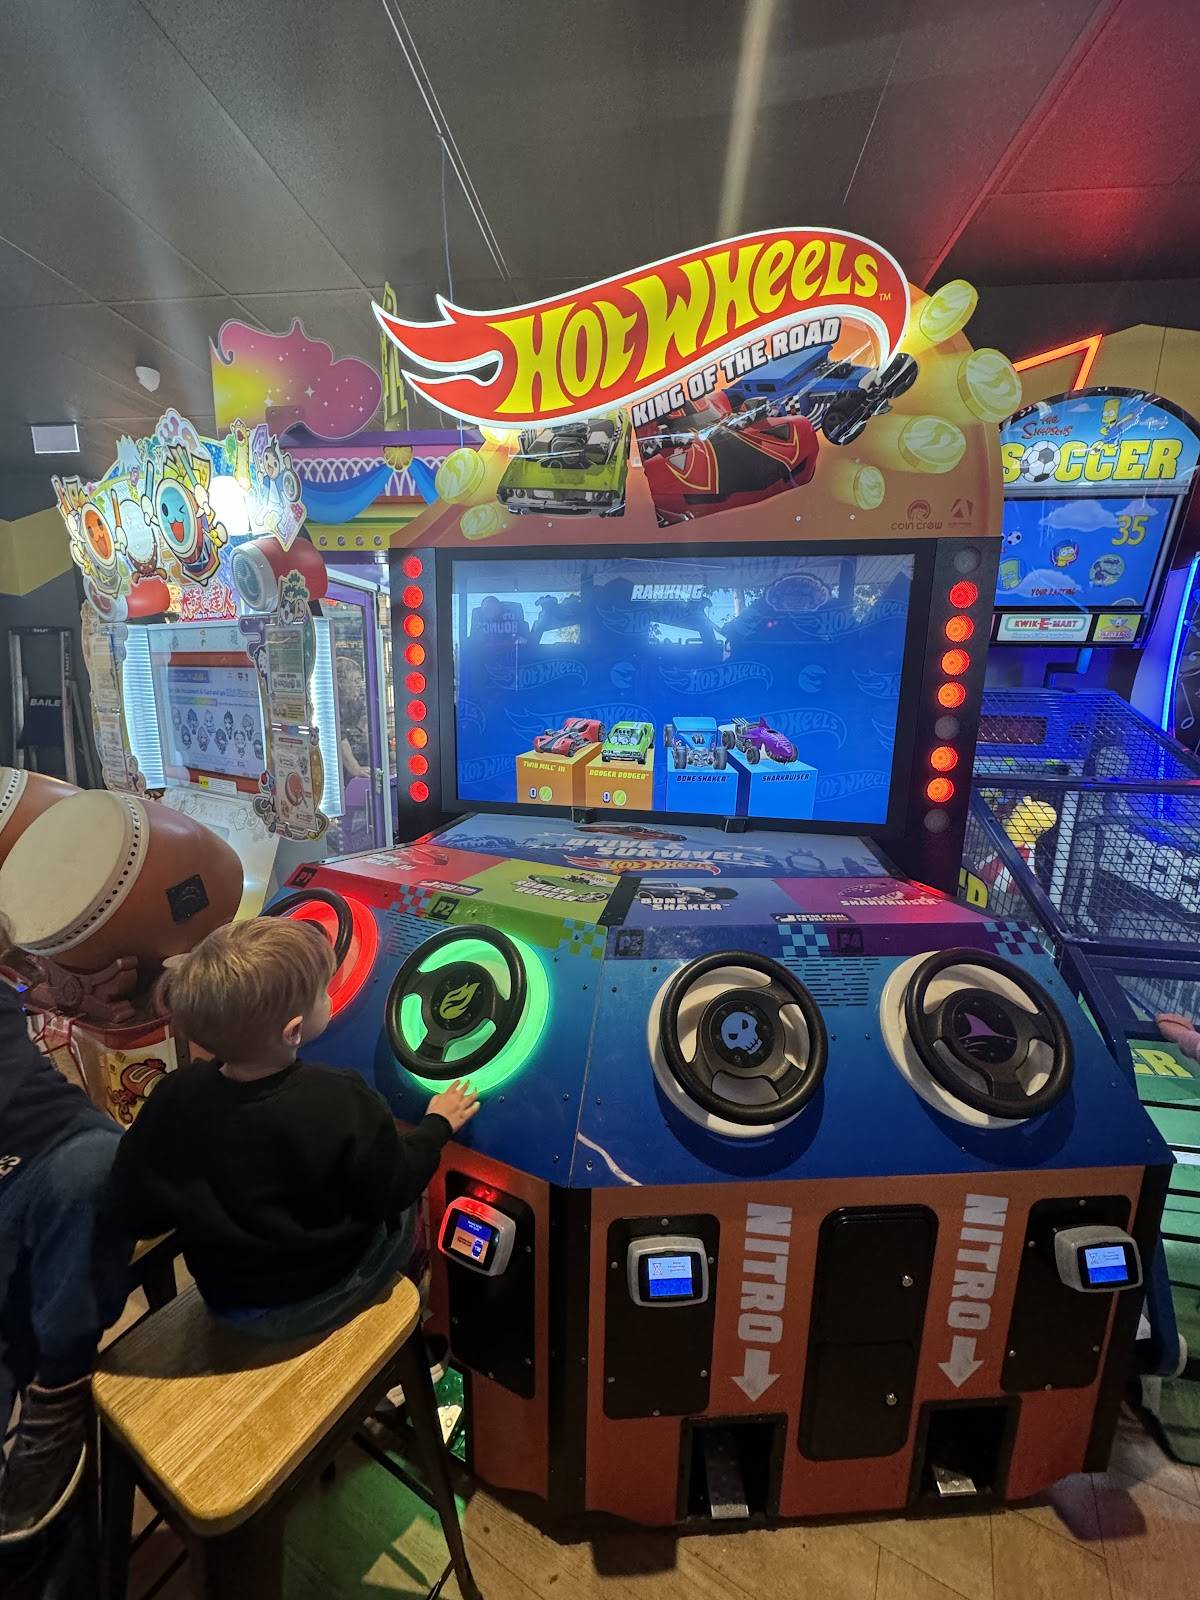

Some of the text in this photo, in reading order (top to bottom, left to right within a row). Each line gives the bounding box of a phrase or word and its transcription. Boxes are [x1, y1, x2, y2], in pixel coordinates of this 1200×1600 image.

[485, 300, 638, 414] HOT
[622, 238, 879, 384] WHEELS
[632, 317, 840, 428] KING OF THE ROAD
[890, 521, 914, 531] coin
[916, 521, 943, 531] crew
[1111, 514, 1149, 546] 35
[630, 584, 704, 601] RANKING
[1014, 617, 1079, 631] KWIK-E-MART
[697, 775, 727, 783] SHAKER
[564, 838, 656, 849] DRIVE
[594, 847, 744, 861] SURVIVE!
[640, 897, 688, 905] BONE
[652, 903, 723, 911] SHAKER
[947, 1193, 1009, 1331] NITRO
[737, 1202, 793, 1344] NITRO
